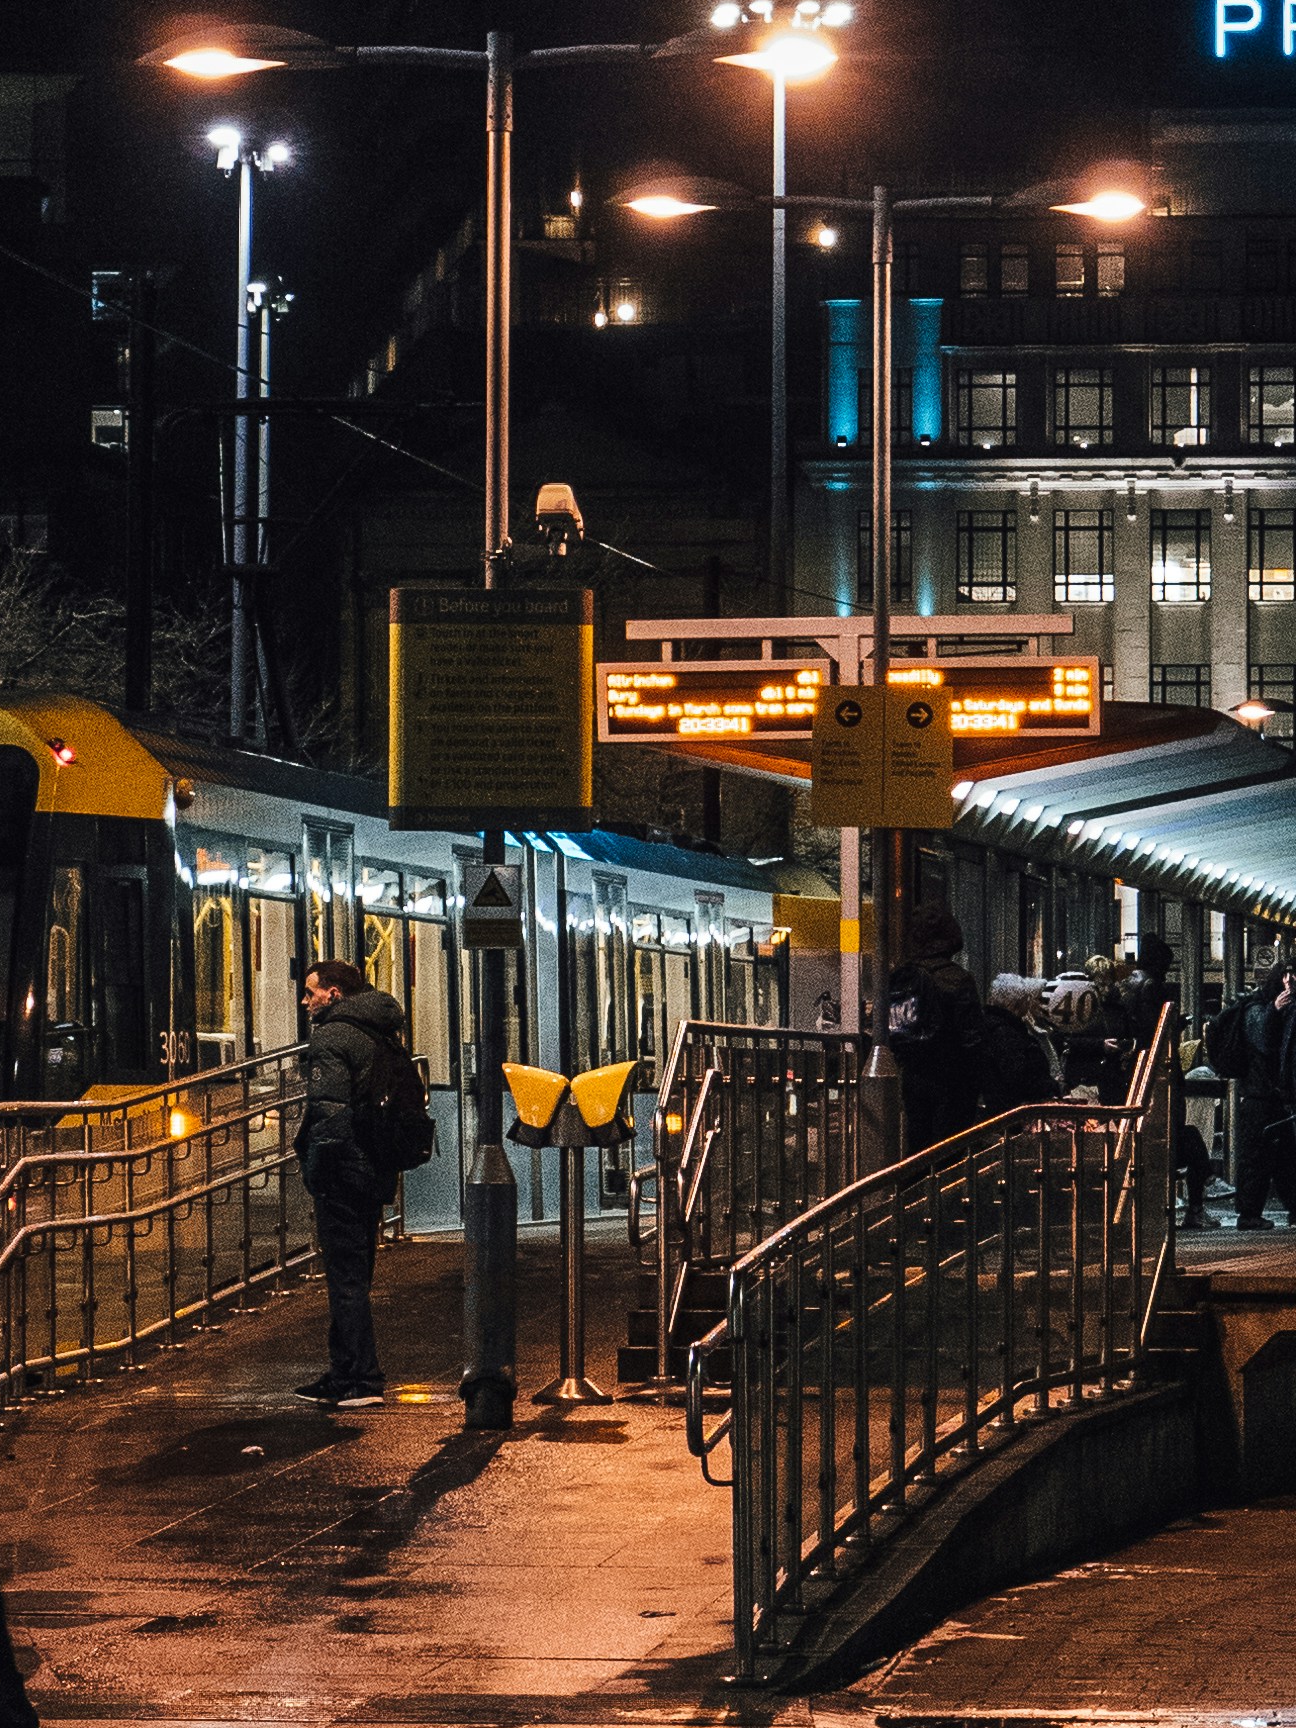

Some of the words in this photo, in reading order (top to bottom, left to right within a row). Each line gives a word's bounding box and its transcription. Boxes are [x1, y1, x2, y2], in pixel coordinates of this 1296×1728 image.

[439, 597, 489, 613] Before
[493, 601, 521, 616] you
[525, 599, 569, 614] board
[1065, 668, 1090, 682] min
[607, 689, 640, 705] Bury
[1066, 683, 1090, 697] min
[963, 699, 1026, 714] Saturdays
[1028, 699, 1052, 711] and
[1052, 990, 1096, 1026] 40
[159, 1030, 191, 1065] 3060
